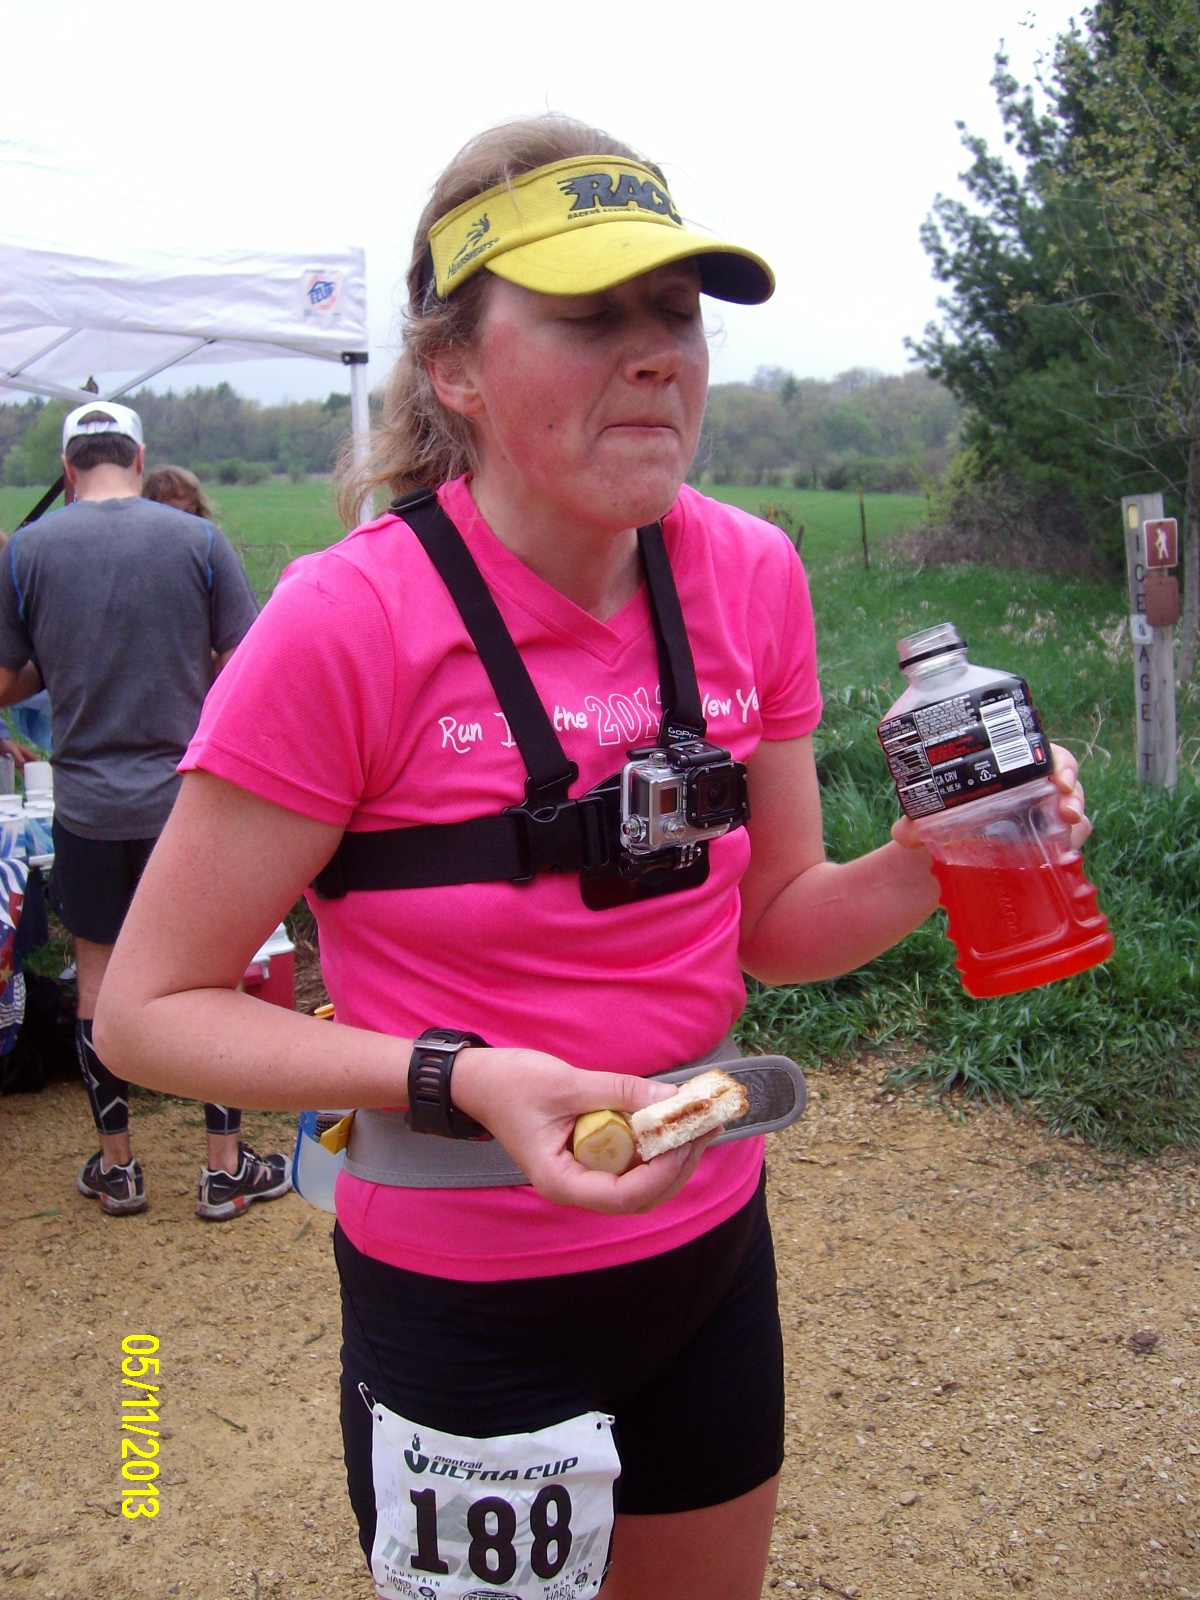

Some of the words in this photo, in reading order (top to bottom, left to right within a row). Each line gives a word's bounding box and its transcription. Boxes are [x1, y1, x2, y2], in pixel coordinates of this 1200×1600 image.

[1139, 646, 1151, 722] AGE
[438, 716, 483, 754] Run
[553, 705, 588, 732] the
[584, 684, 662, 746] 201
[668, 726, 699, 738] GoPro
[935, 775, 945, 786] CA
[944, 770, 958, 783] CRV
[429, 1461, 519, 1481] ULTRA
[523, 1456, 579, 1480] CUP
[434, 1455, 483, 1470] montrail
[410, 1484, 573, 1585] 188
[384, 1564, 441, 1587] MOUNTAIN
[386, 1573, 411, 1589] HARD
[544, 1562, 592, 1592] MOUNTAIN
[394, 1583, 419, 1600] WEAR
